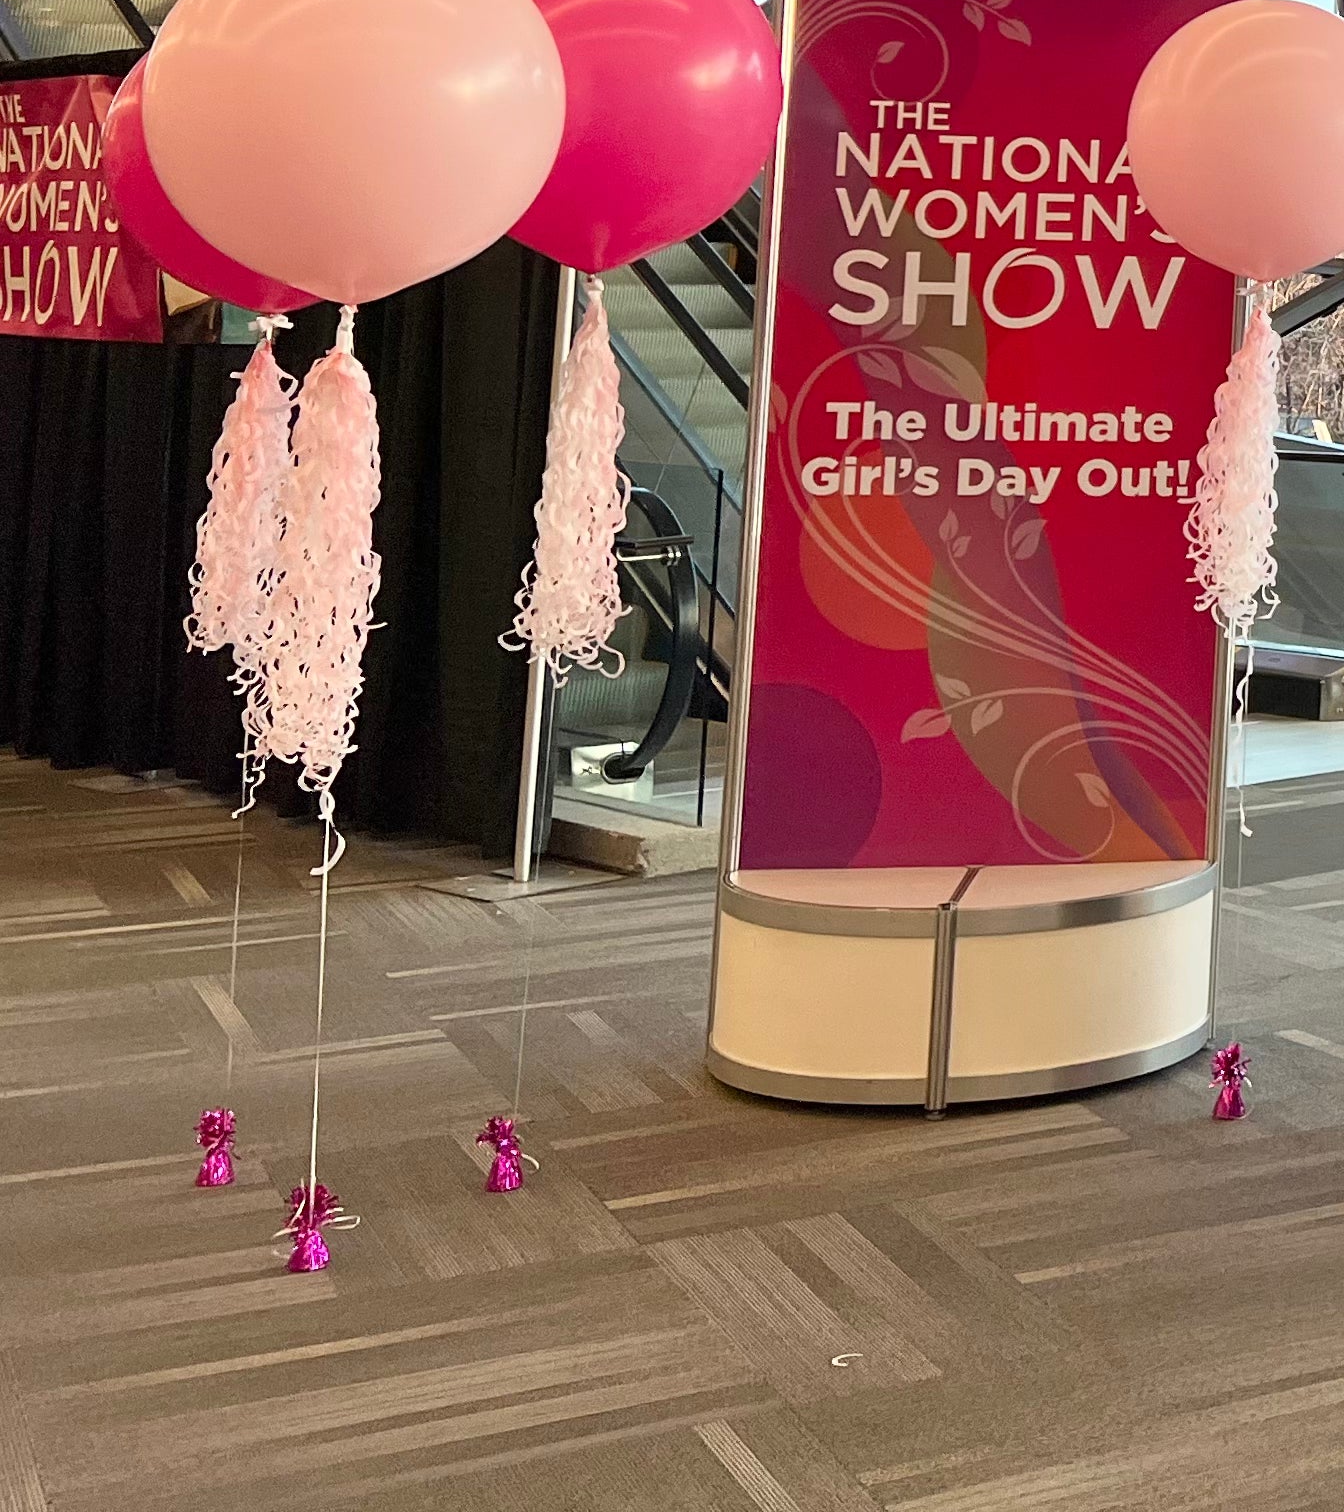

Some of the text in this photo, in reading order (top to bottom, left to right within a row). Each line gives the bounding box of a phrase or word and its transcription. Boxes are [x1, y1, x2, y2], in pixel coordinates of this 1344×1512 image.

[869, 100, 951, 131] THE
[835, 131, 1132, 184] NATIONA
[0, 239, 119, 328] HOW
[828, 247, 1186, 331] SHOW
[826, 401, 1173, 443] The Ultimate
[801, 456, 1191, 505] Girl's Day Out!
